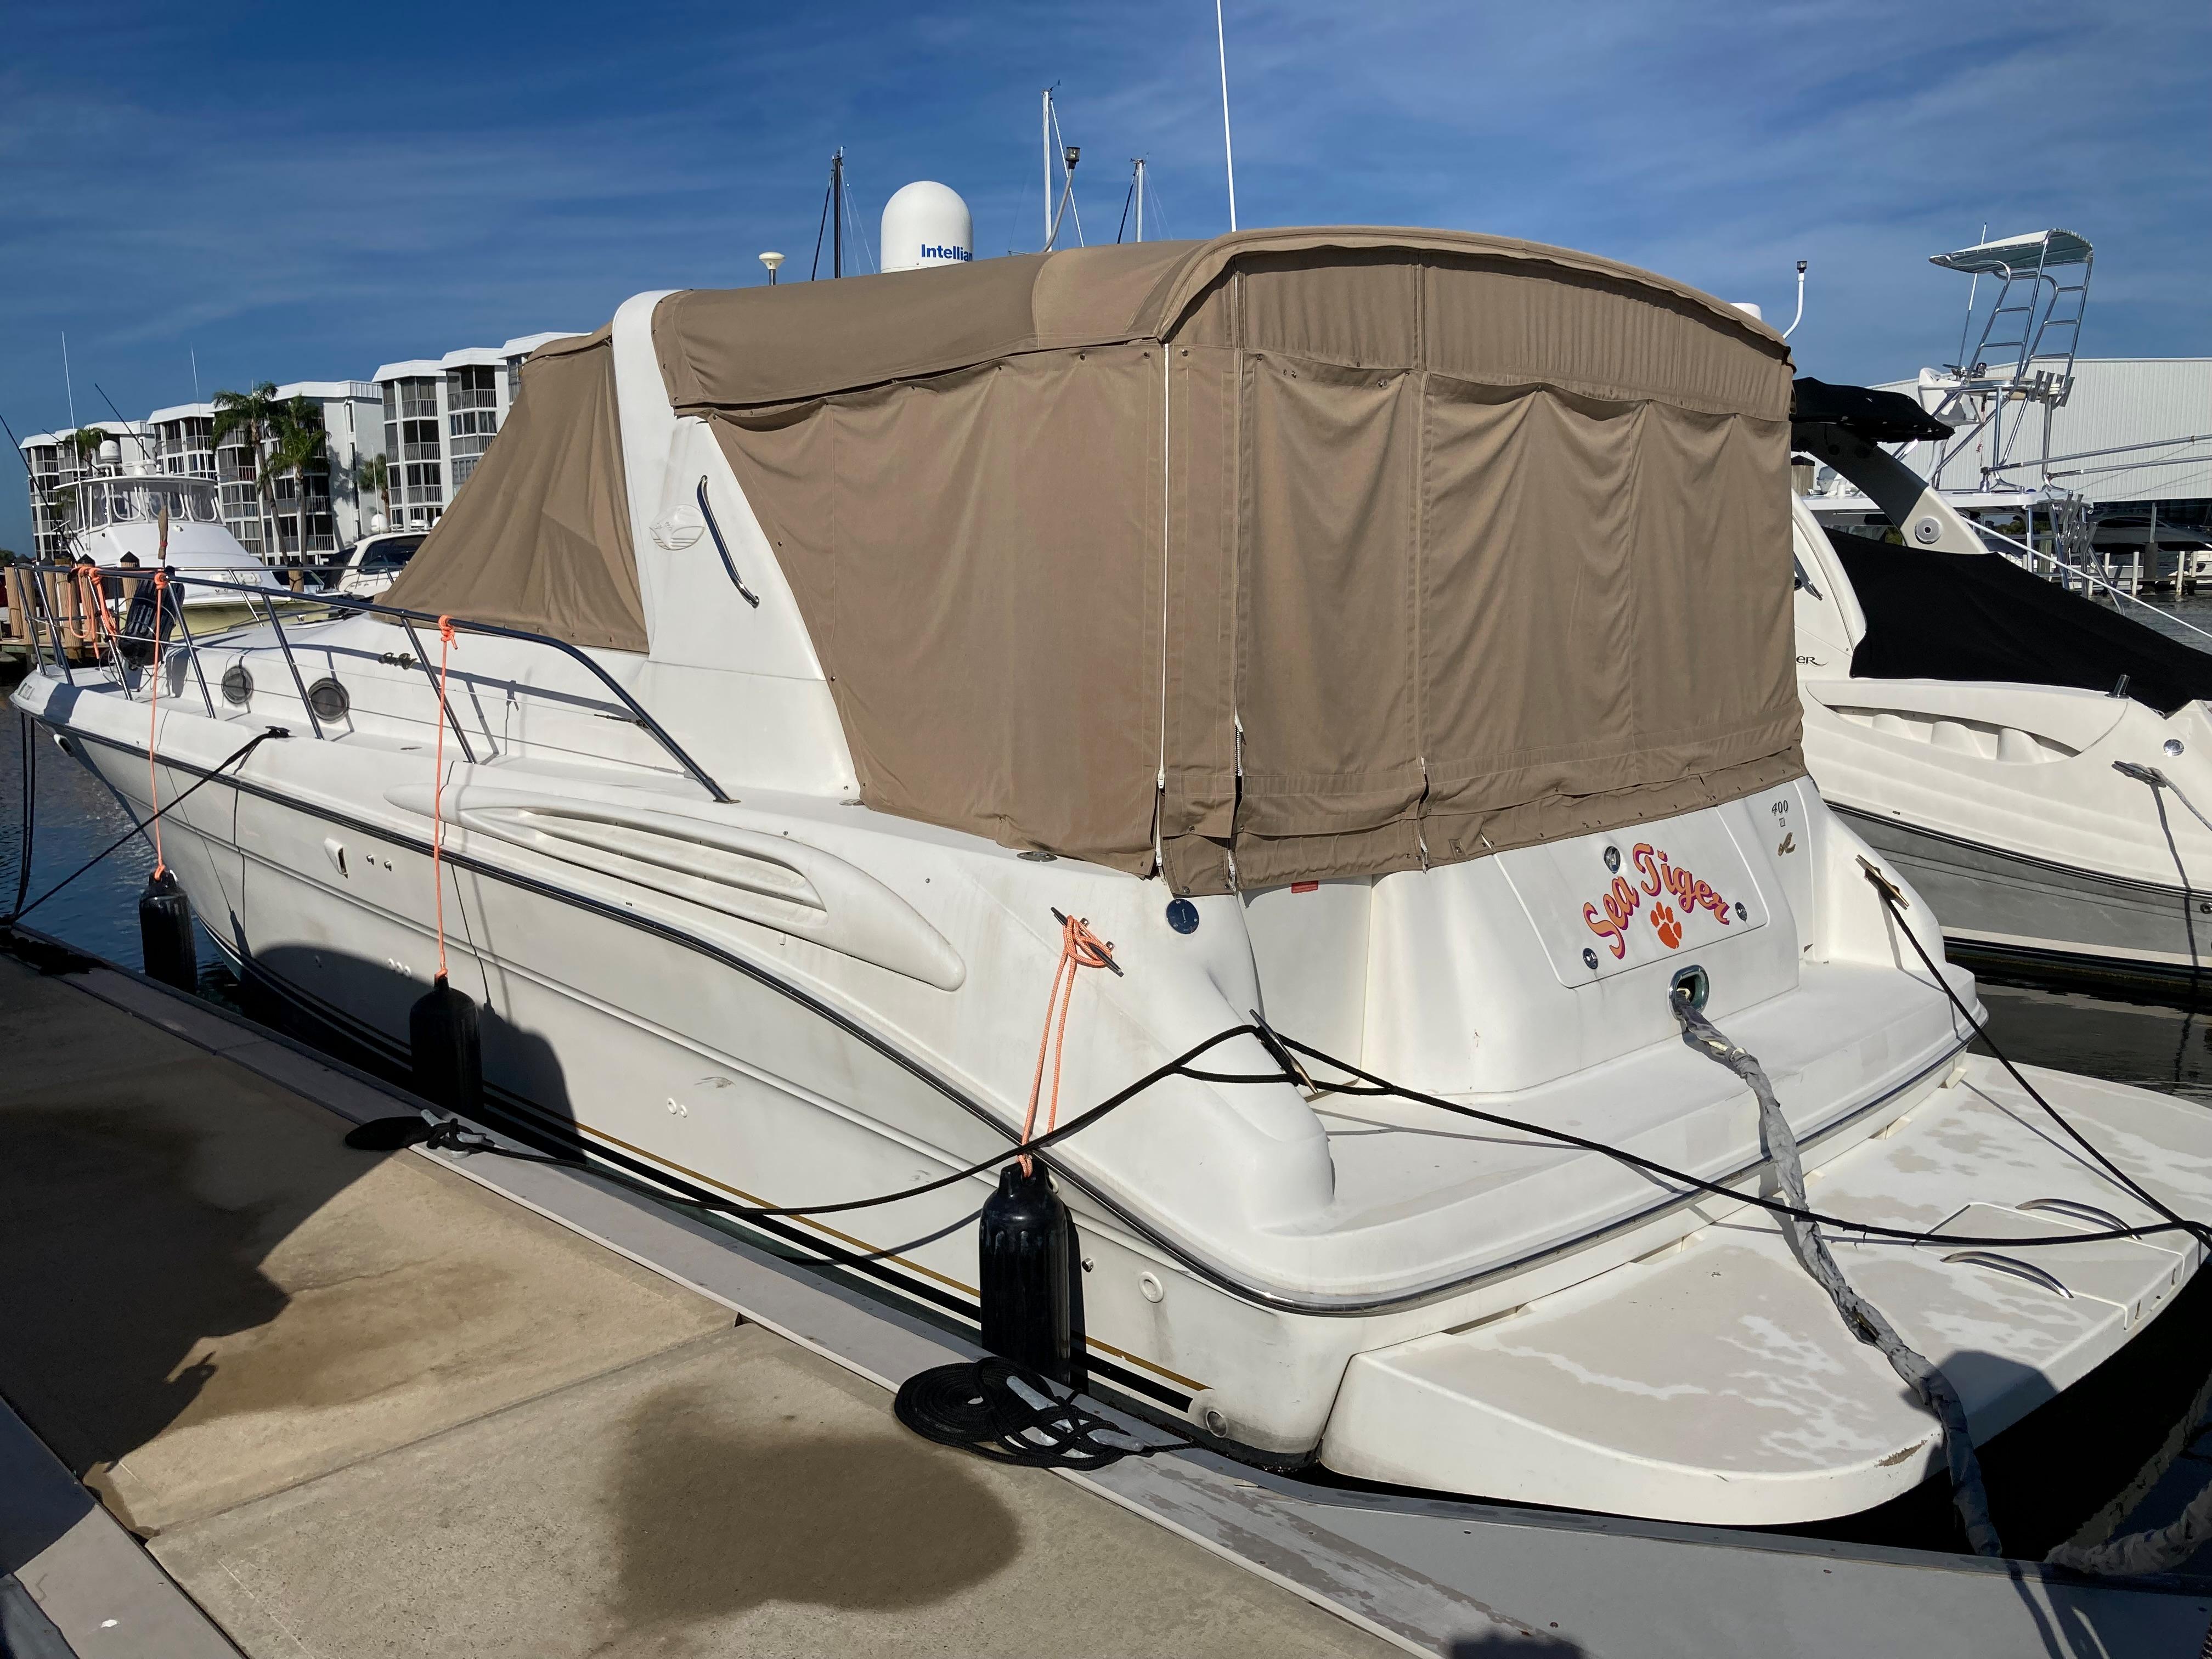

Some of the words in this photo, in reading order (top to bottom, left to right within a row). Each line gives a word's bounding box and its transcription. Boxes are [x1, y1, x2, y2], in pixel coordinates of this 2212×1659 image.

[922, 244, 973, 262] Intellian
[1771, 800, 1788, 815] 400
[1583, 876, 1640, 960] Sea
[1632, 843, 1730, 925] Tiger
